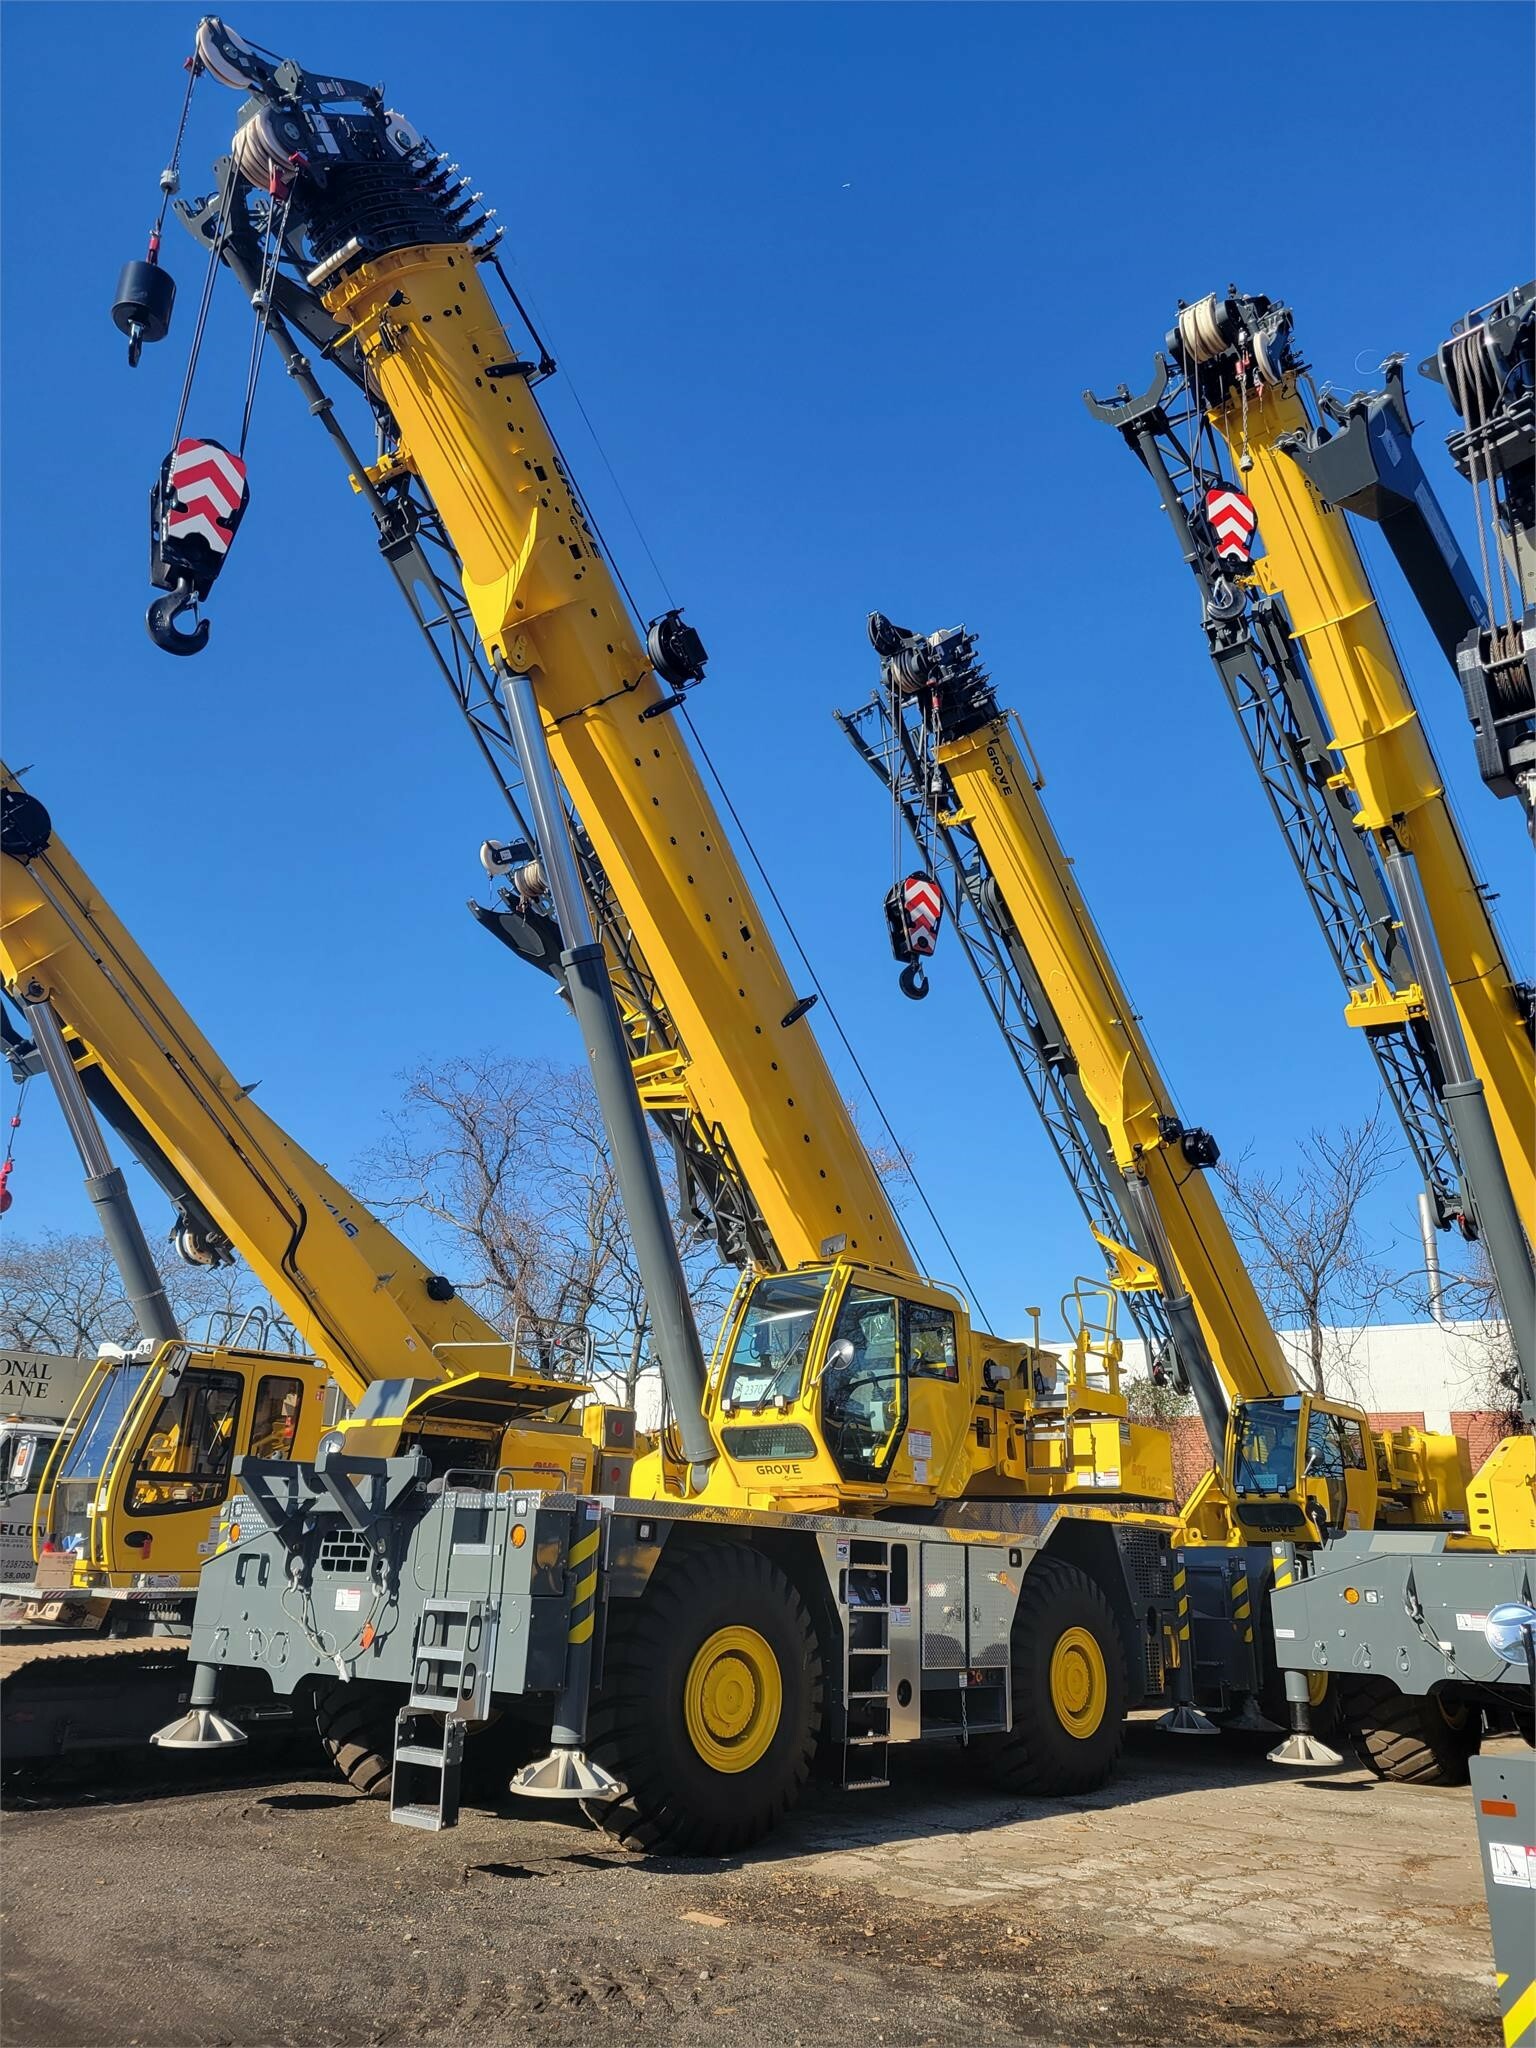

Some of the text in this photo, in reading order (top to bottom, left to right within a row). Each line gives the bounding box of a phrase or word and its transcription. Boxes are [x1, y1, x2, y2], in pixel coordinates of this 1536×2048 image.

[553, 456, 604, 560] GROVE
[986, 746, 1012, 796] GROVE
[756, 1464, 802, 1475] GROVE
[1259, 1526, 1296, 1534] GROVE
